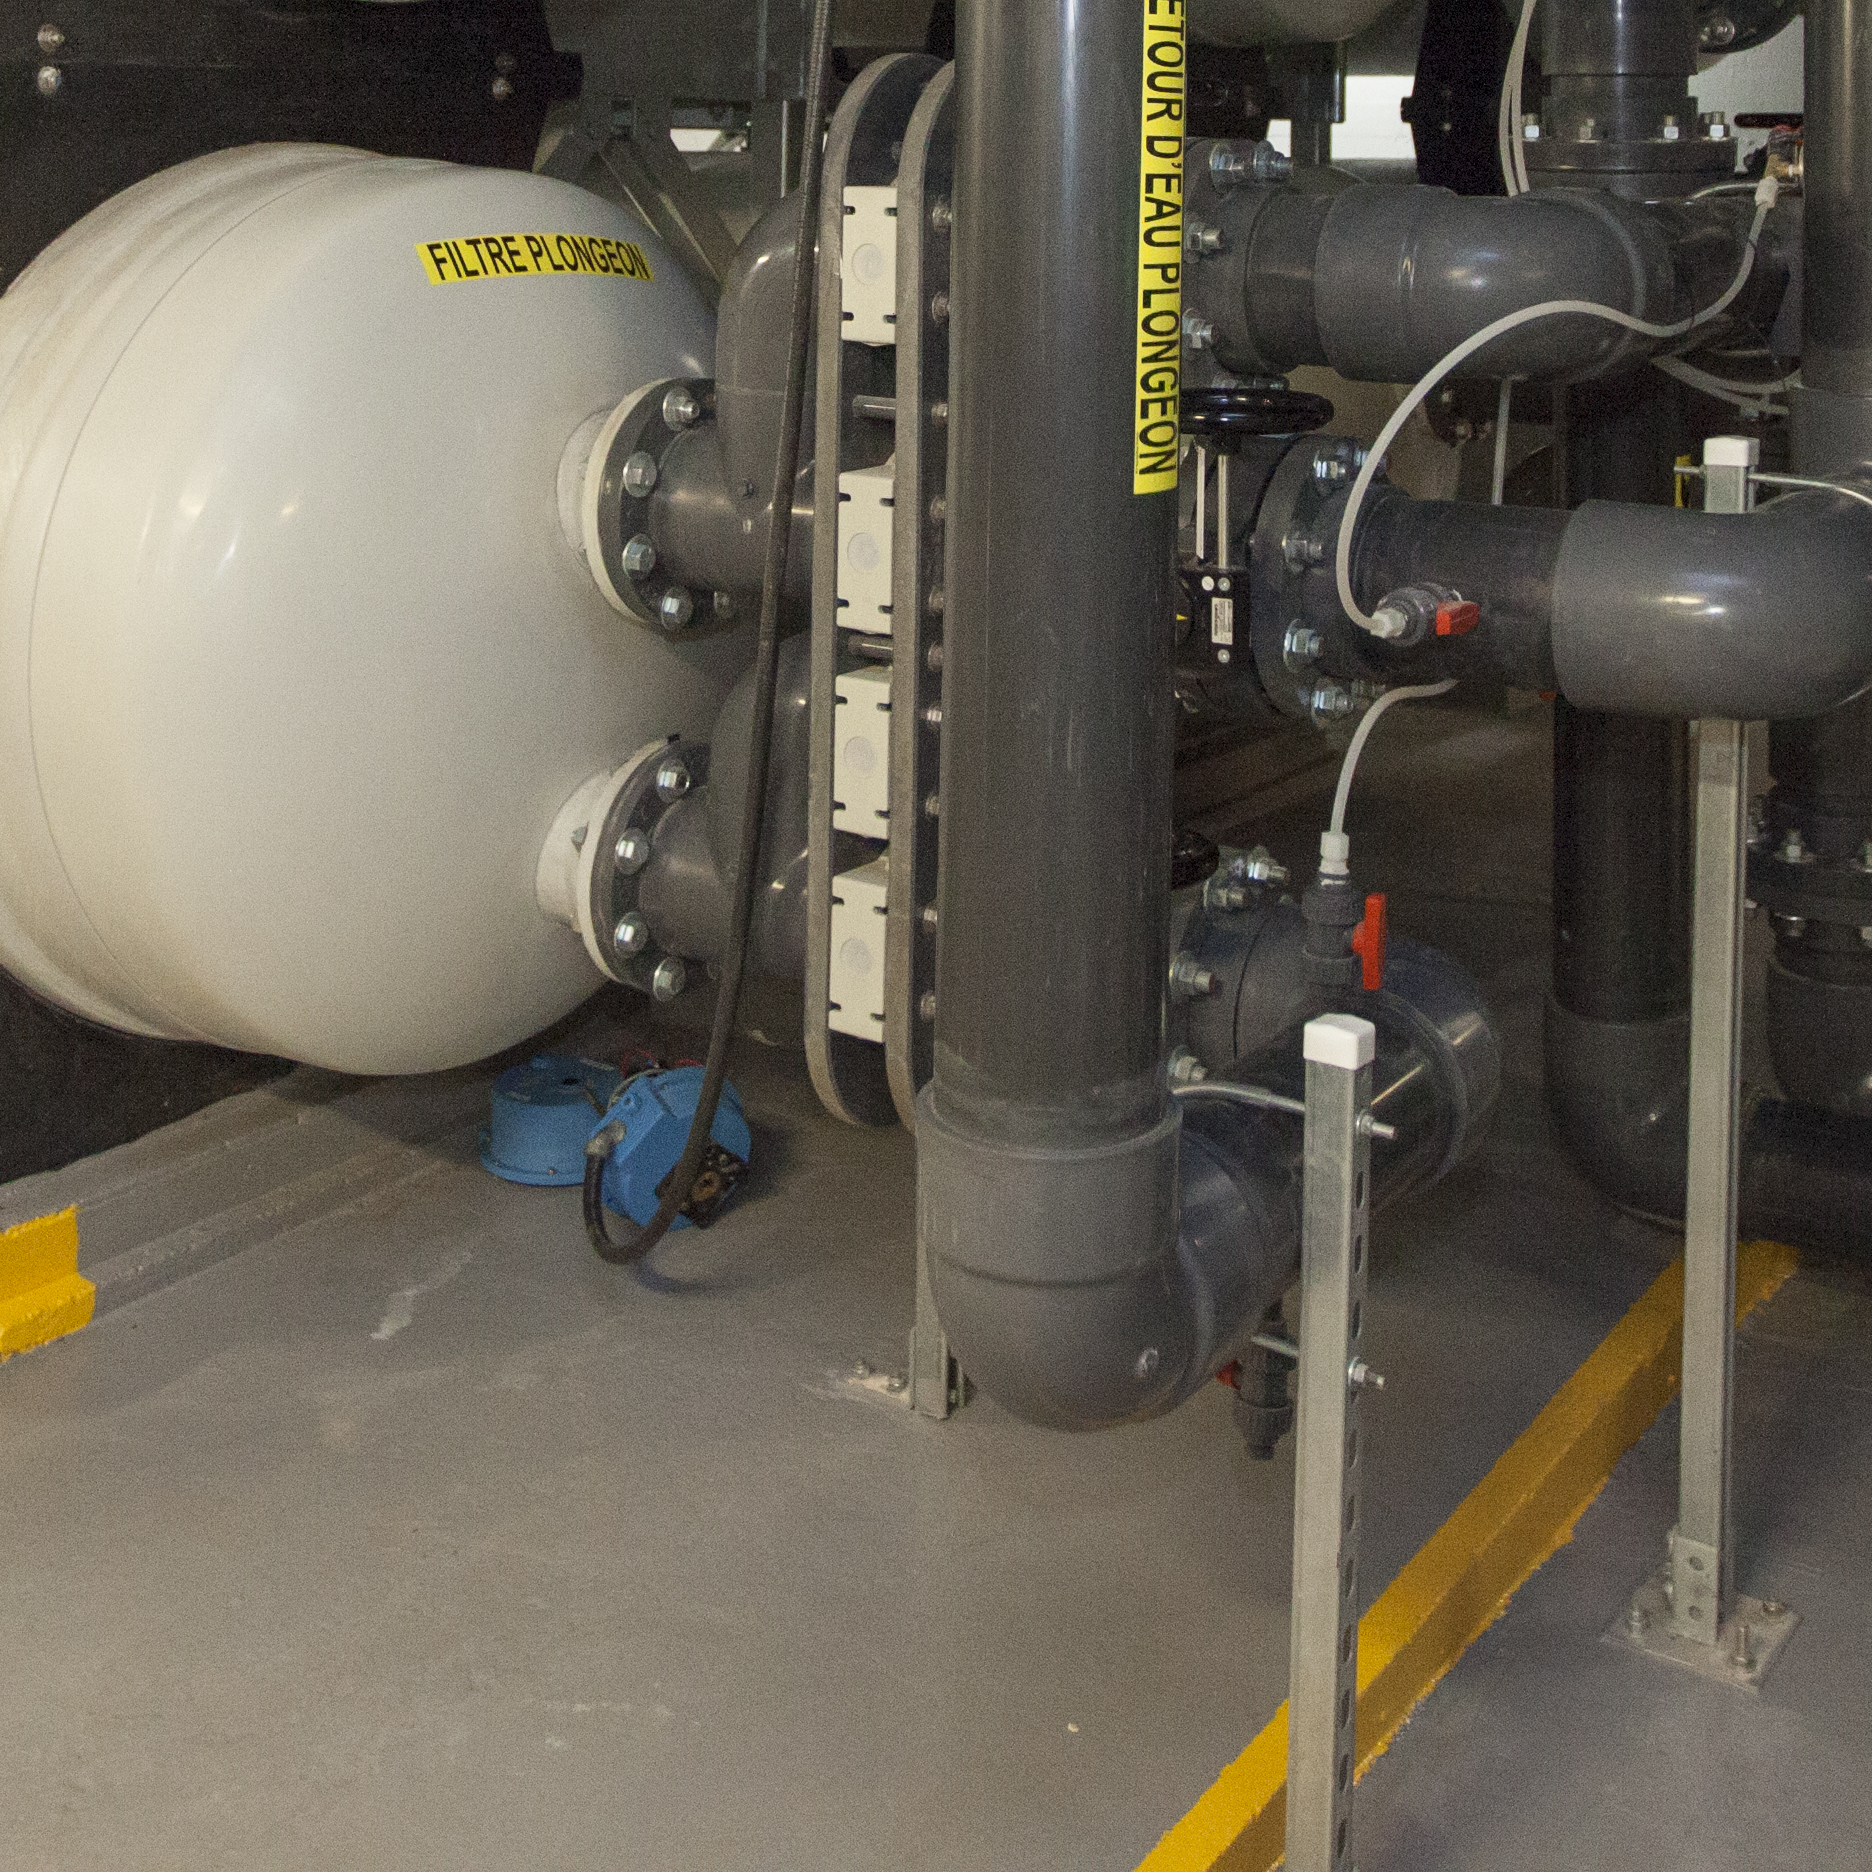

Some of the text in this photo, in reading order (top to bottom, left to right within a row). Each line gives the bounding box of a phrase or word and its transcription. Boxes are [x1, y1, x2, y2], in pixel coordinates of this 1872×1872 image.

[1143, 135, 1184, 248] D'EAU
[426, 233, 651, 281] FILTRE PLONGEON
[1139, 262, 1180, 475] PLONGEON
